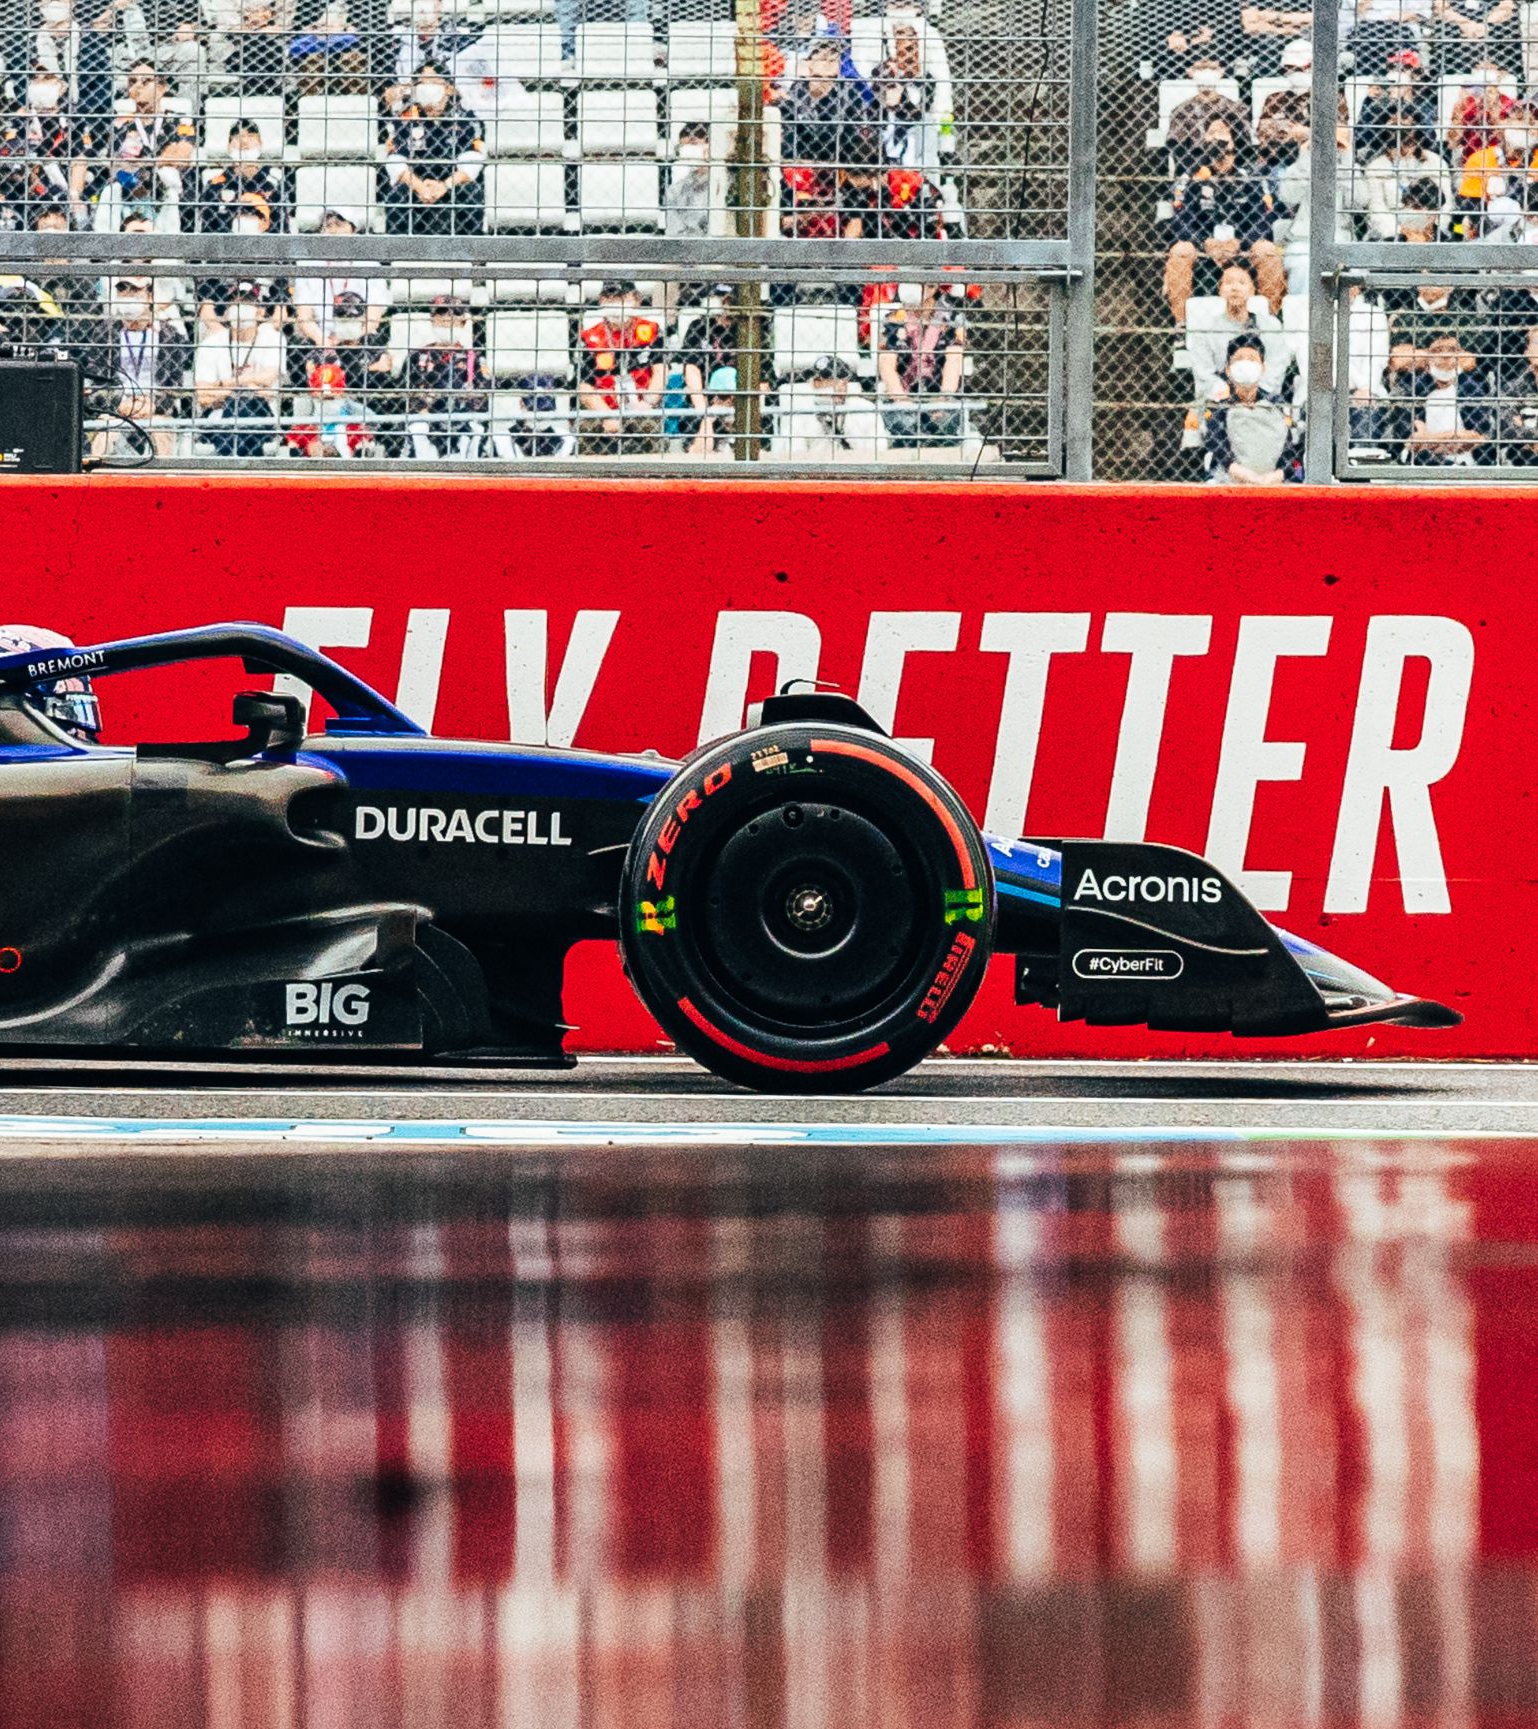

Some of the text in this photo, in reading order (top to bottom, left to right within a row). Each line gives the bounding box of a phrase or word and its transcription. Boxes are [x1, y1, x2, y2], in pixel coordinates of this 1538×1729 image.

[27, 650, 105, 677] BREMONT
[355, 806, 573, 846] DURACELL
[646, 761, 733, 891] ZERO
[1073, 868, 1223, 903] Acronis
[916, 931, 976, 1024] PIRELLI
[1089, 956, 1165, 974] #CyberFit
[286, 982, 371, 1025] BIG
